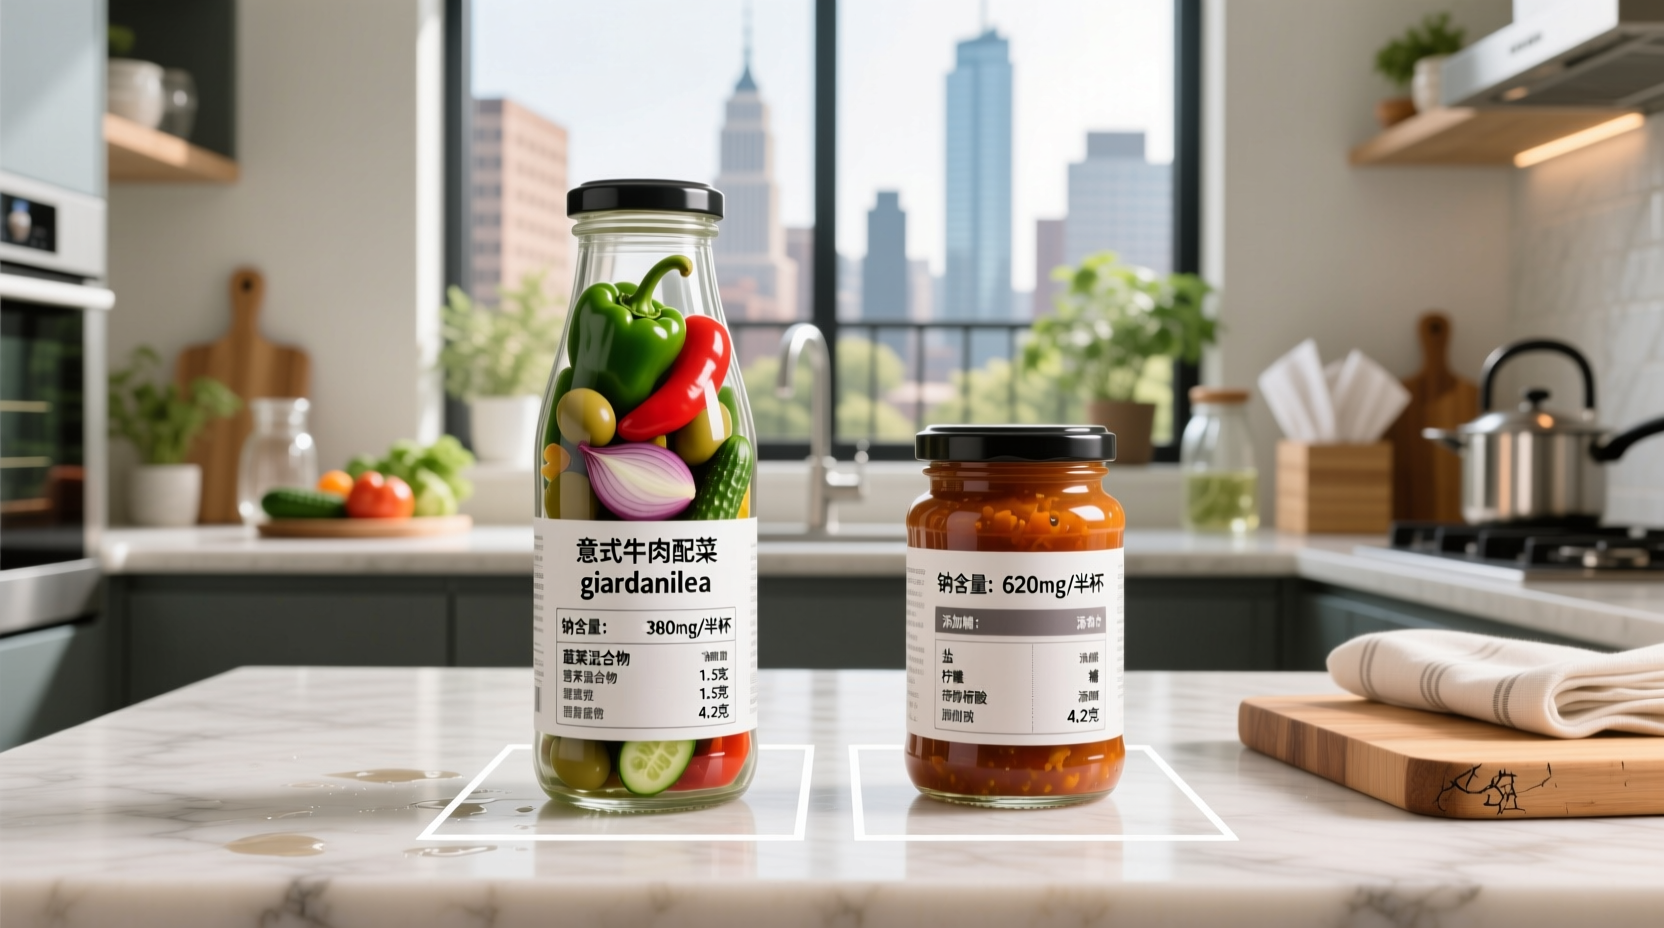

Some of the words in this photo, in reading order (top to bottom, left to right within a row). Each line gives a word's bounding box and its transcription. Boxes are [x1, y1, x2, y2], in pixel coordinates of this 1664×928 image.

[576, 536, 718, 564] 意式牛肉配菜
[580, 570, 711, 600] giardanilea
[1002, 572, 1105, 599] 620mg/半杯
[646, 616, 732, 639] 380mg/半杯
